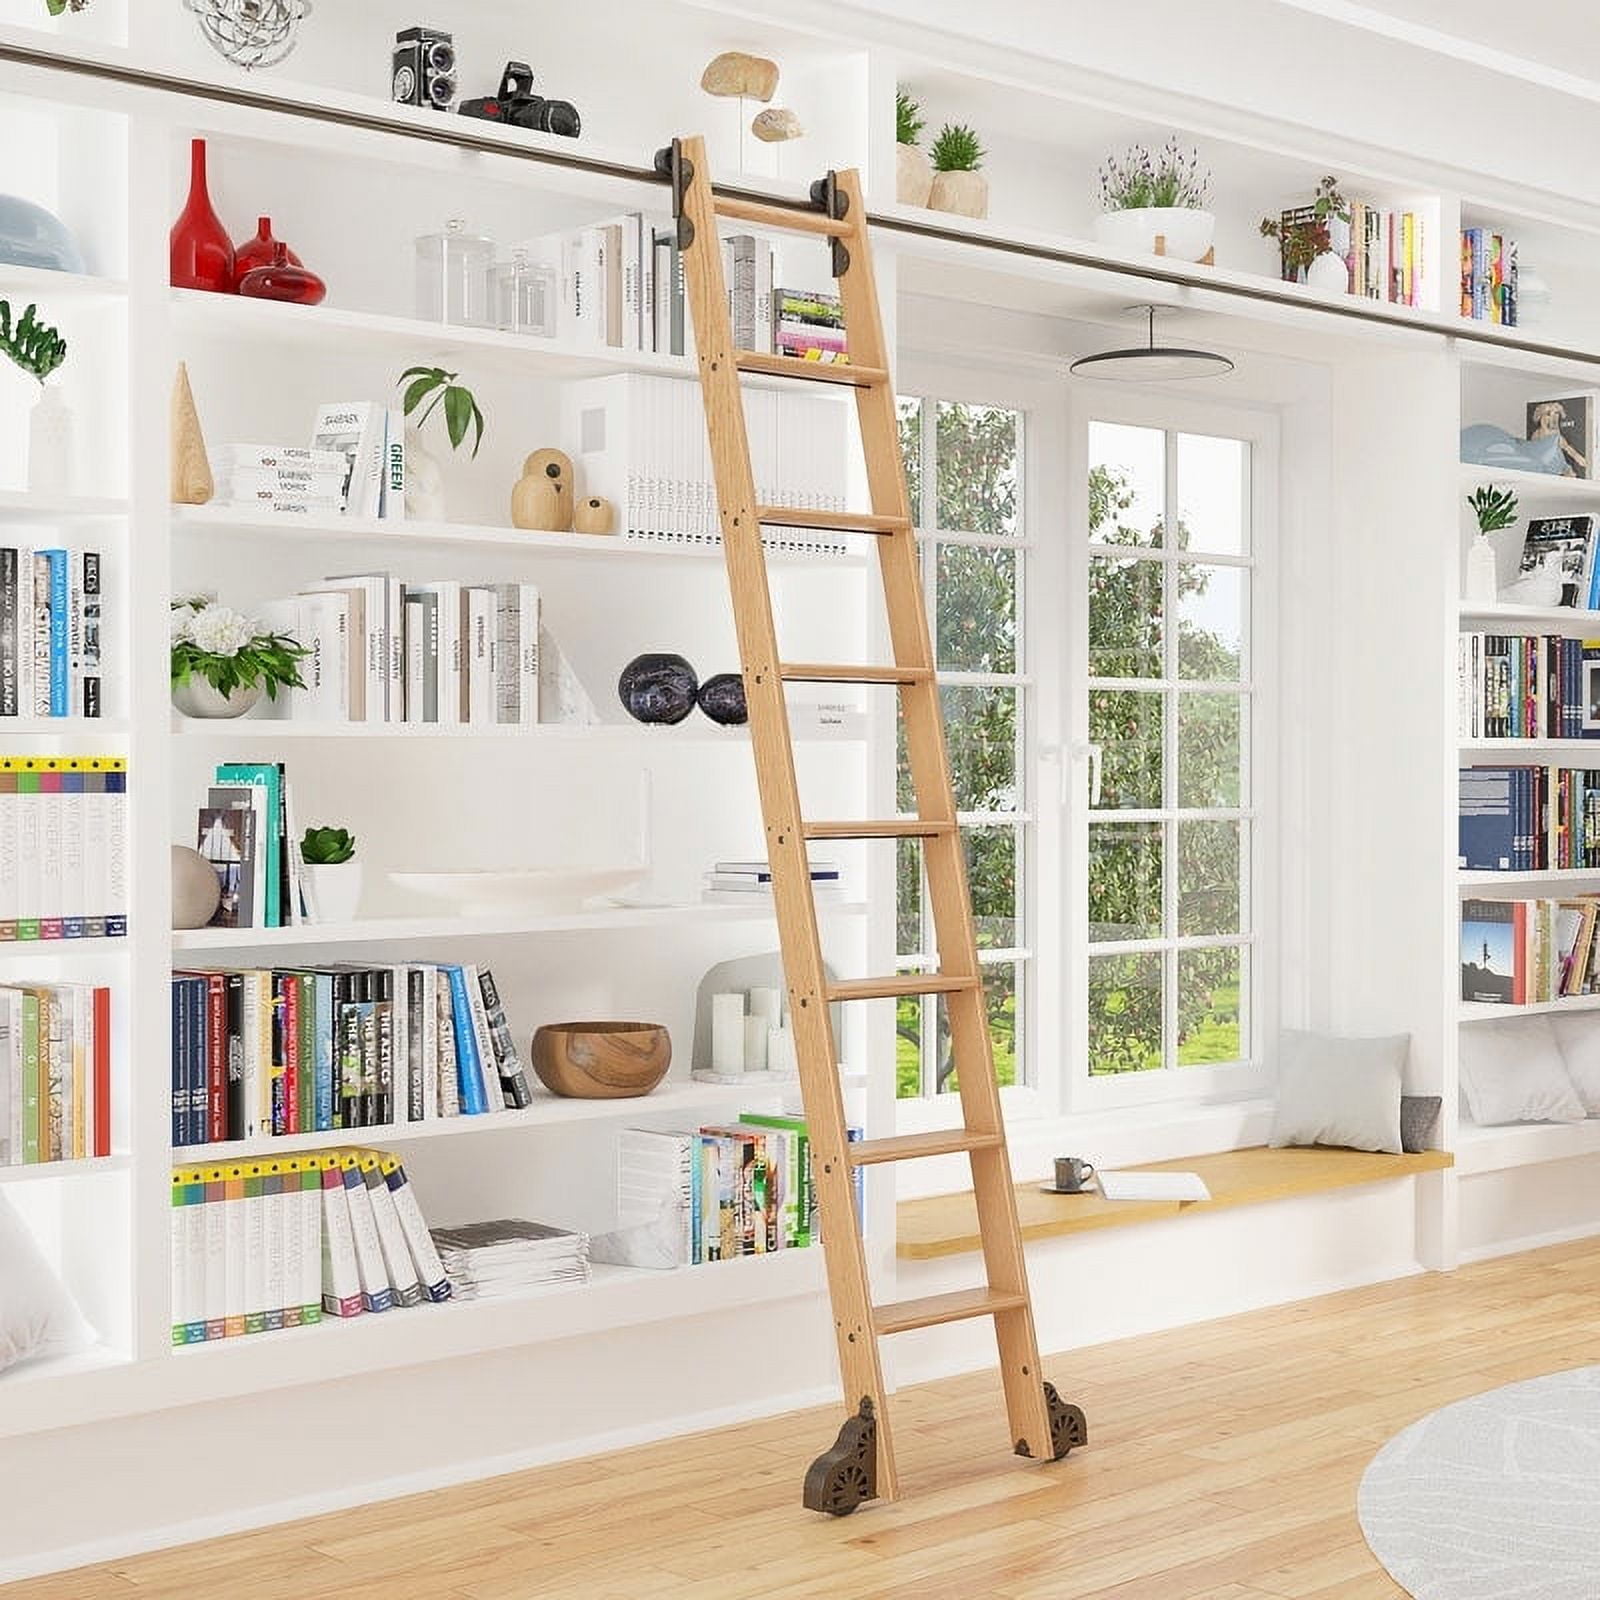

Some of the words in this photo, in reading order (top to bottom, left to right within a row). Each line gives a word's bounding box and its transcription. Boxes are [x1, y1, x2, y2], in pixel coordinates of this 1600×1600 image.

[391, 443, 403, 492] GREEN
[381, 1010, 391, 1034] THE
[381, 1037, 391, 1084] AZTECS
